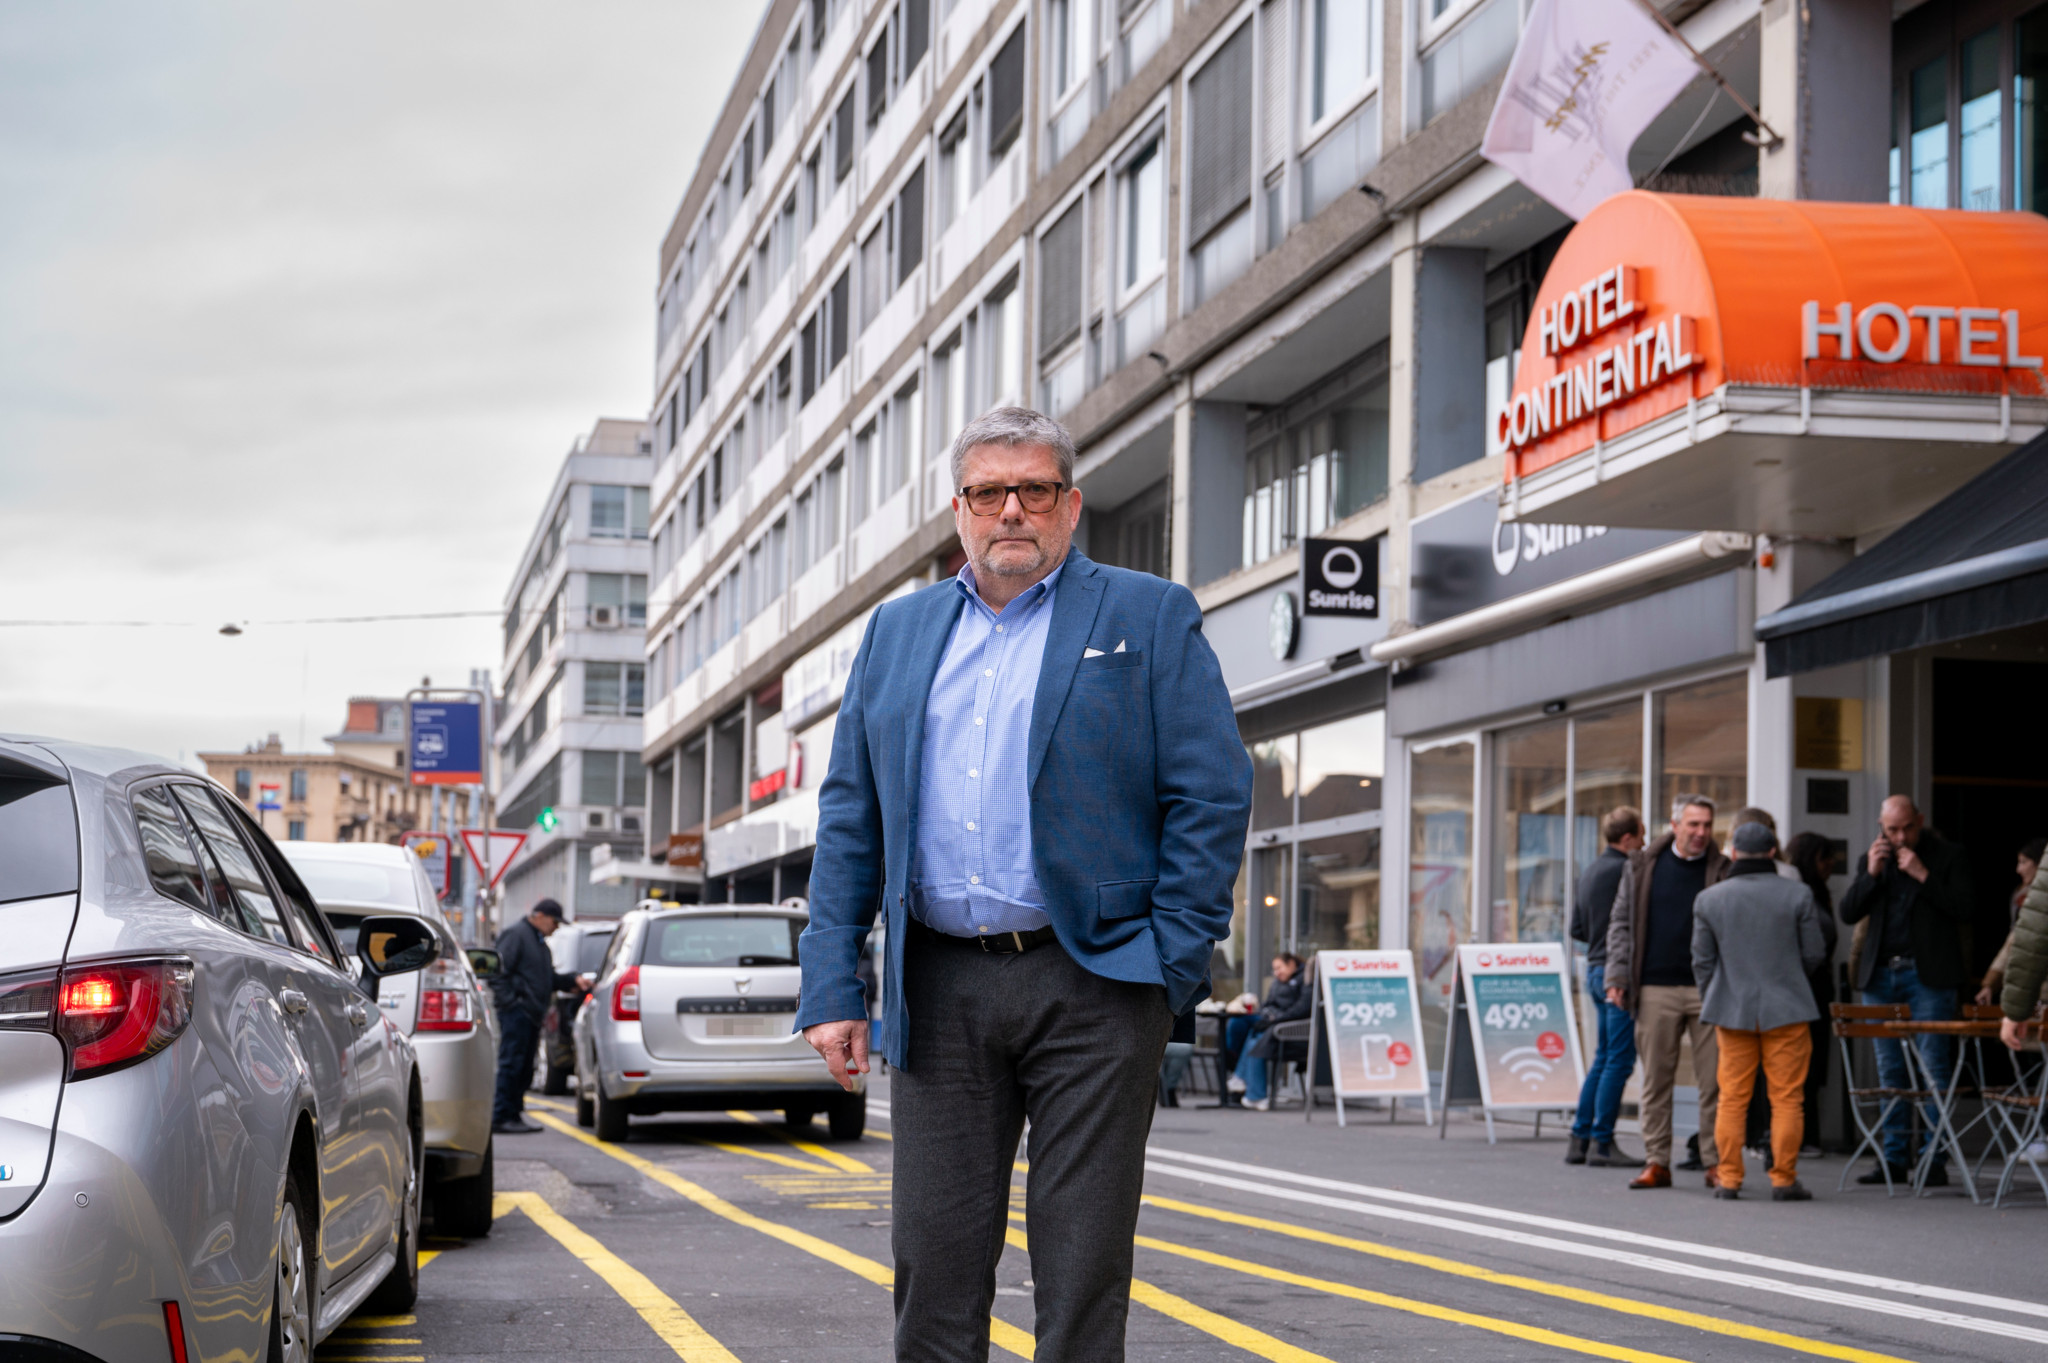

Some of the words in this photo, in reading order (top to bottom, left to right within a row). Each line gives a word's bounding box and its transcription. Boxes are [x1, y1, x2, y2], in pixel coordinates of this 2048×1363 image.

[1540, 265, 1635, 357] HOTEL
[1803, 300, 2044, 368] HOTEL
[1498, 314, 1693, 452] CONTINENTAL
[1308, 589, 1375, 610] Sunrise
[1351, 959, 1399, 970] Sunrise
[1496, 953, 1550, 967] Sunrise
[1338, 1003, 1397, 1026] 29.95
[1485, 1003, 1549, 1029] 49.90
